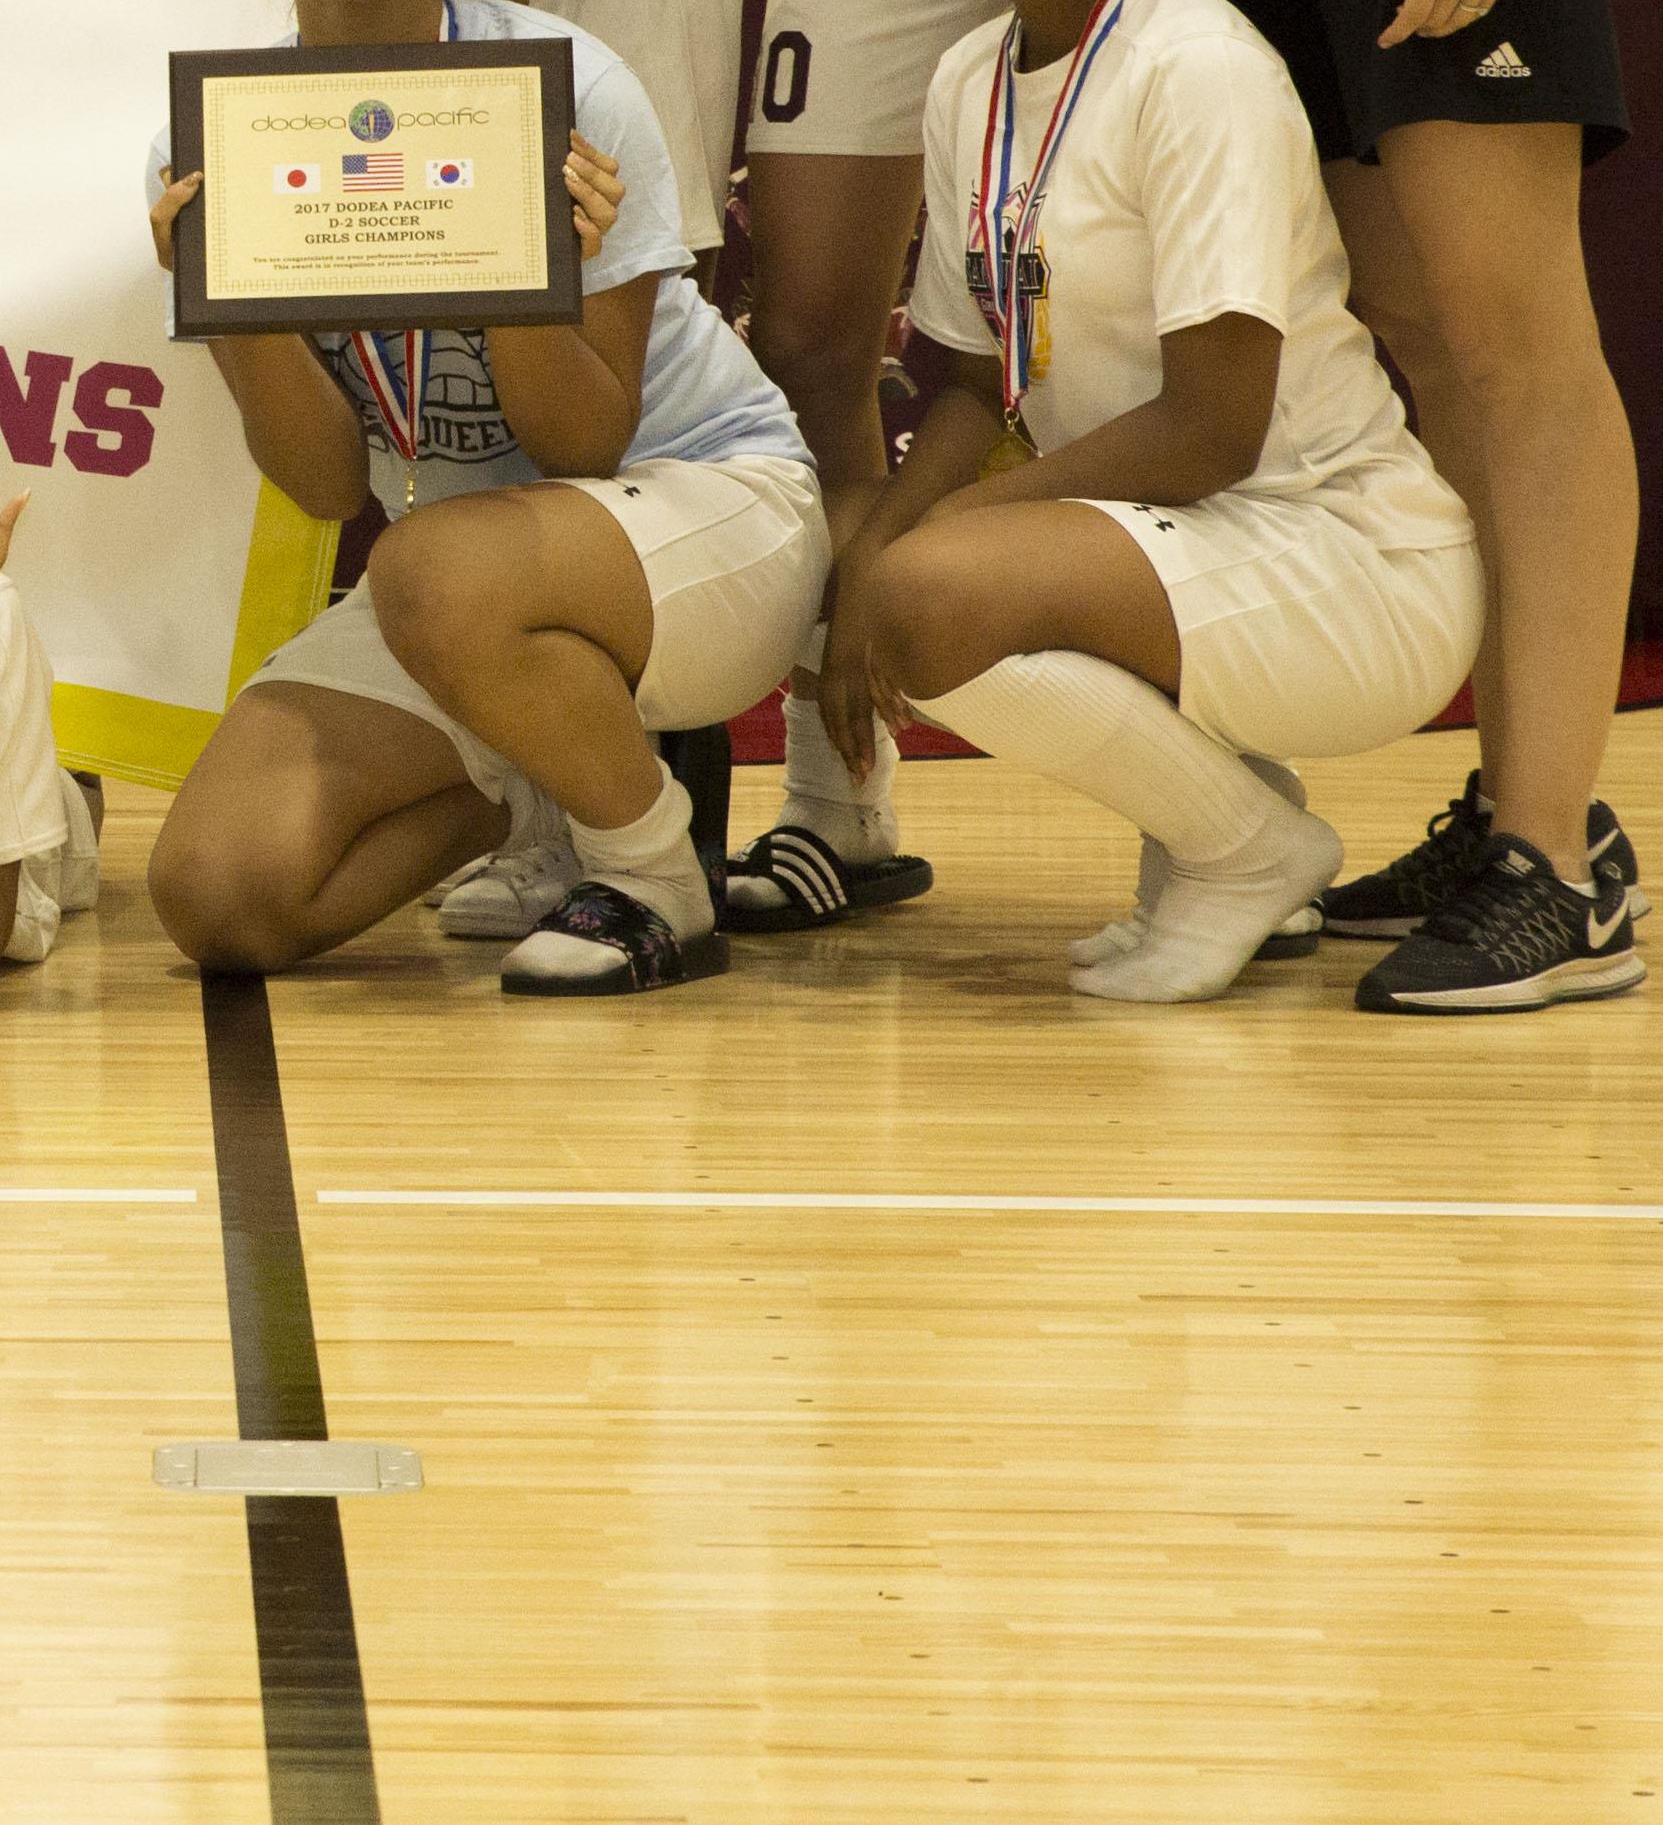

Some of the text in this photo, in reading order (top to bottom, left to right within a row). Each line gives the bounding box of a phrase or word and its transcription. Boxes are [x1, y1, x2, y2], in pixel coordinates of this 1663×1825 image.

[1475, 63, 1532, 78] adidas
[251, 106, 490, 132] dodea pacific
[294, 199, 454, 214] 2017 DODEA PACIFIC
[329, 215, 420, 228] D-2 SOCCER
[304, 229, 446, 244] GIRLS CHAMPIONS
